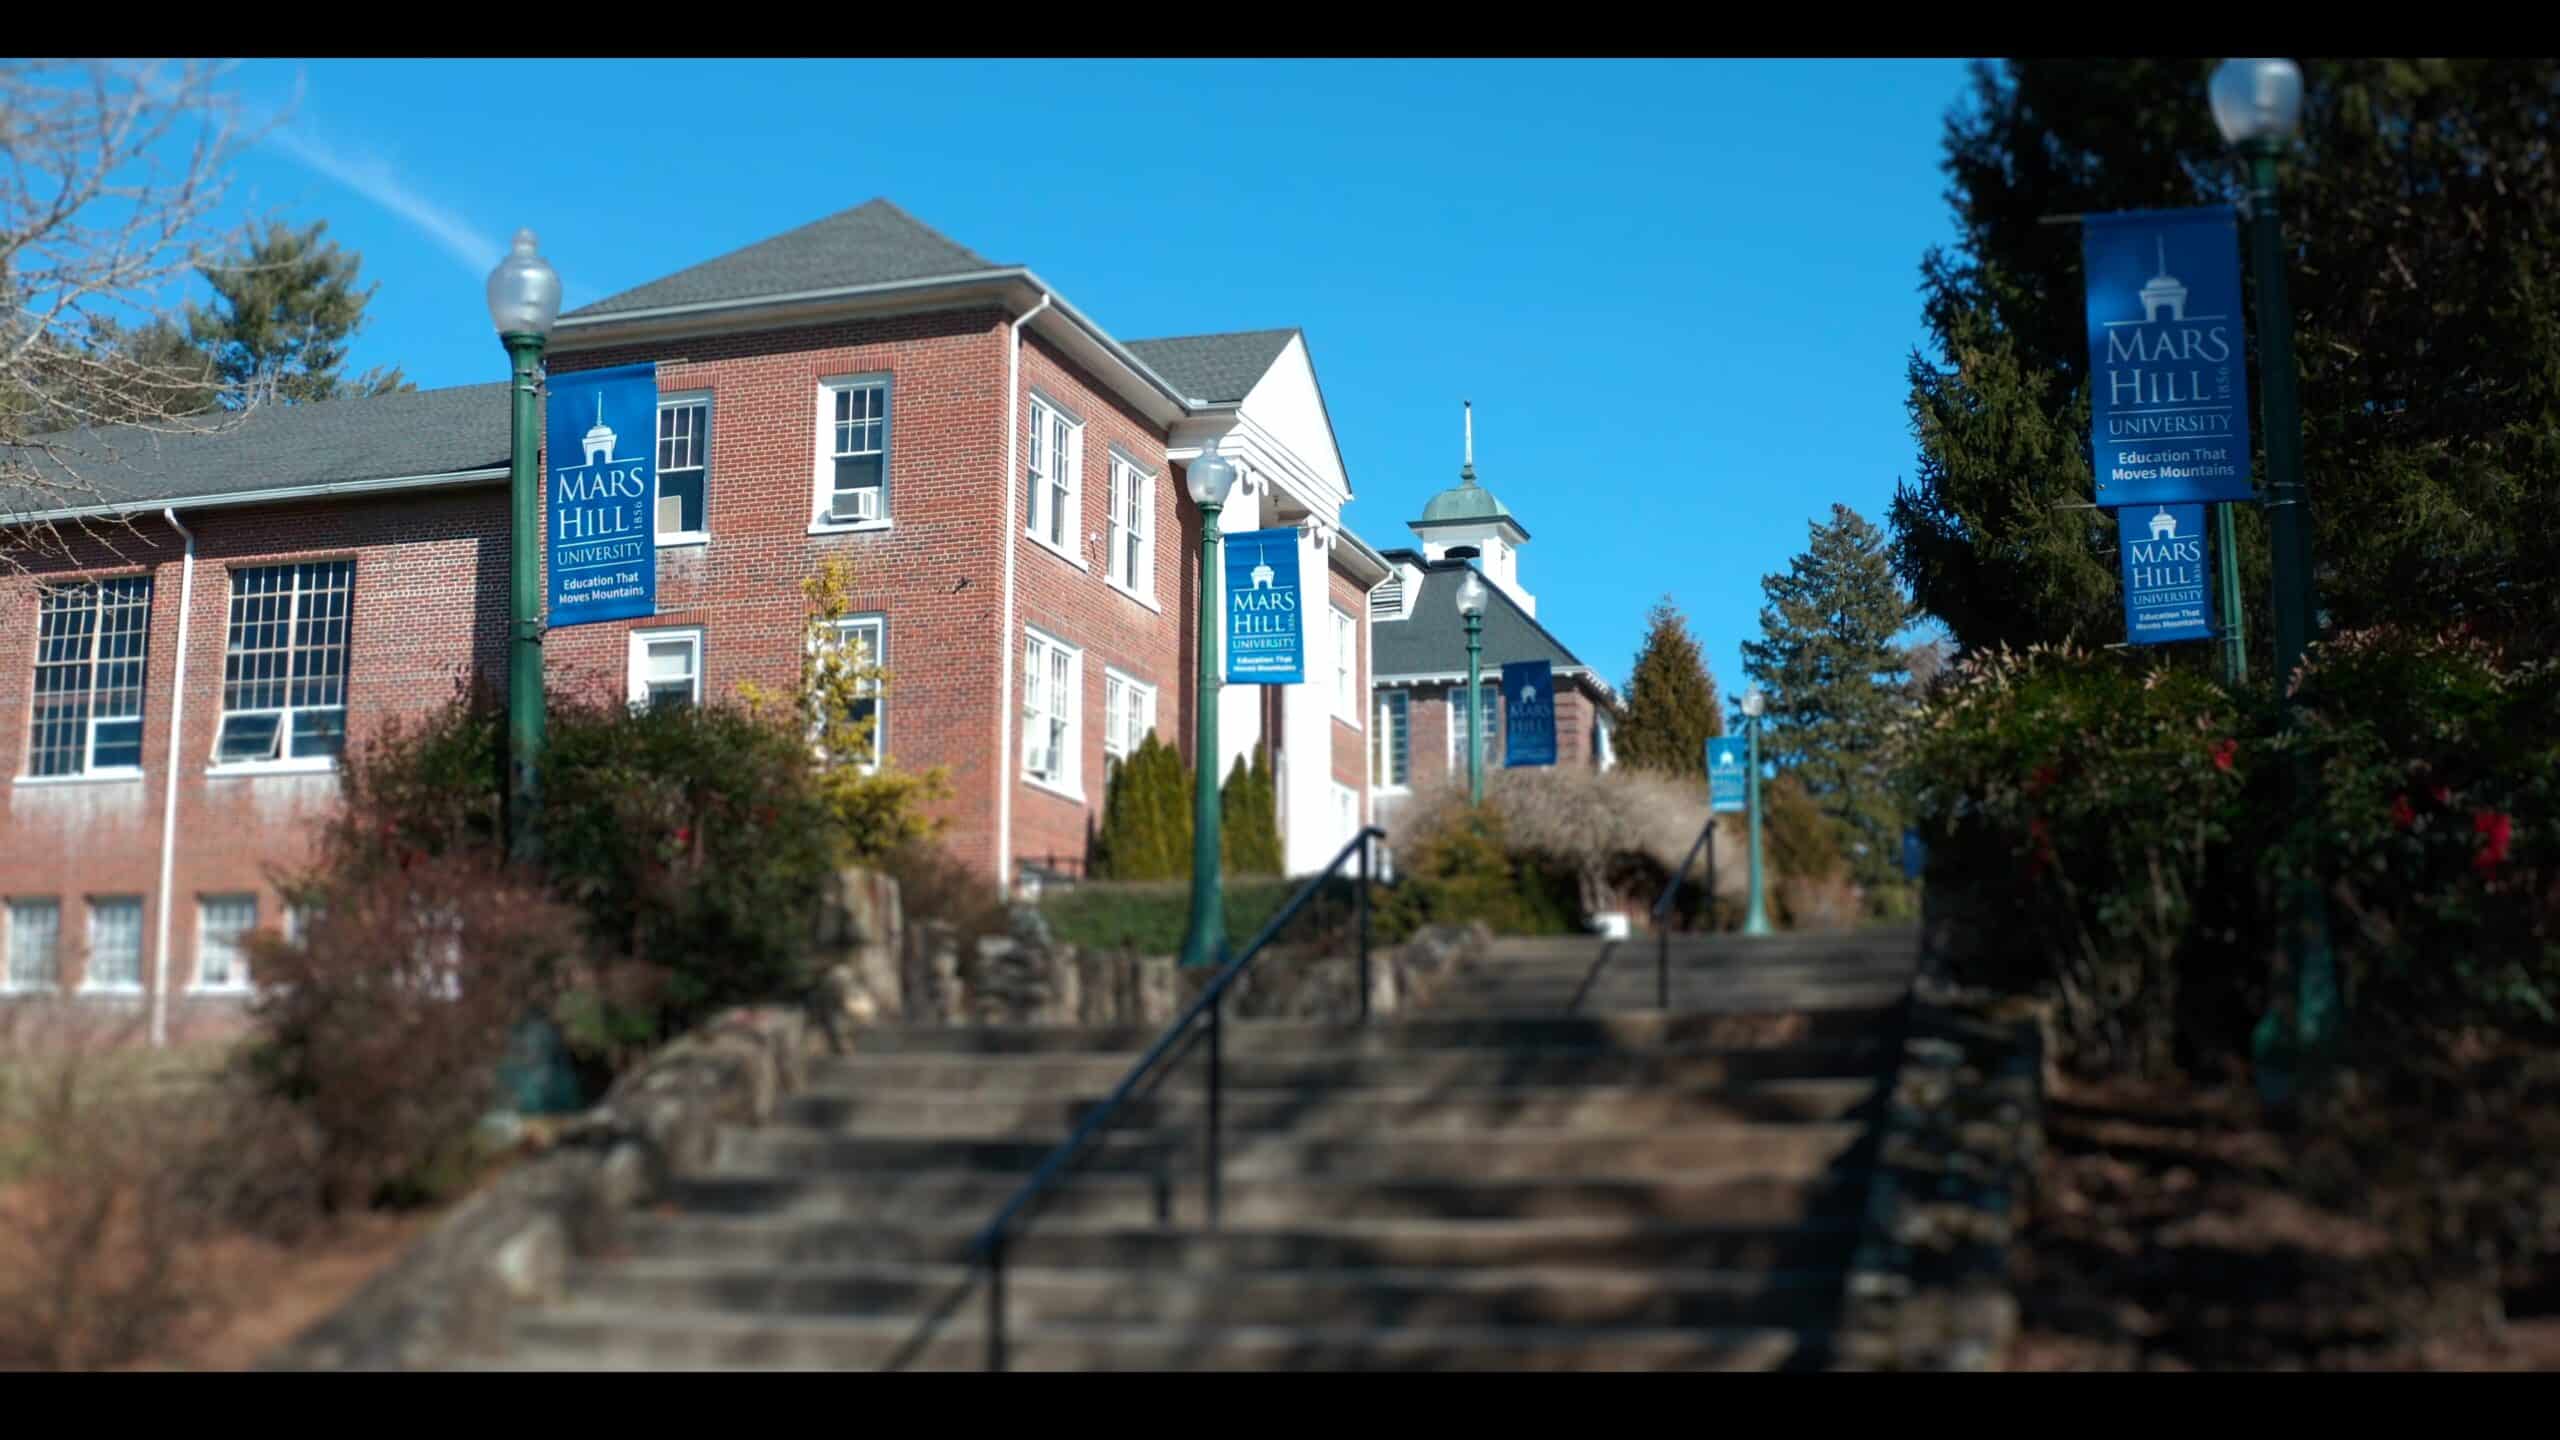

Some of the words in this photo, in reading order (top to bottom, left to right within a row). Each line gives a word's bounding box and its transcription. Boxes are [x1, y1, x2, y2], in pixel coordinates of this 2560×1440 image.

[2106, 327, 2229, 364] MARS
[2109, 368, 2211, 405] HILL
[2216, 368, 2231, 399] 1856
[2109, 415, 2232, 435] UNIVERSITY
[2119, 450, 2190, 464] Education
[2195, 448, 2227, 461] That
[2112, 468, 2157, 480] Moves
[2160, 464, 2235, 478] Mountains
[556, 467, 644, 503] MARS
[558, 506, 629, 539] HILL
[633, 502, 643, 529] 1856
[557, 542, 643, 565] UNIVERSITY
[2132, 541, 2200, 564] MARS
[564, 575, 614, 590] Education
[616, 572, 638, 584] That
[2134, 566, 2190, 588] HILL
[559, 593, 590, 604] Moves
[592, 586, 644, 600] Mountains
[1233, 591, 1295, 612] MARS
[2134, 590, 2202, 605] UNIVERSITY
[1234, 614, 1286, 634] HILL
[1233, 638, 1296, 649] UNIVERSITY
